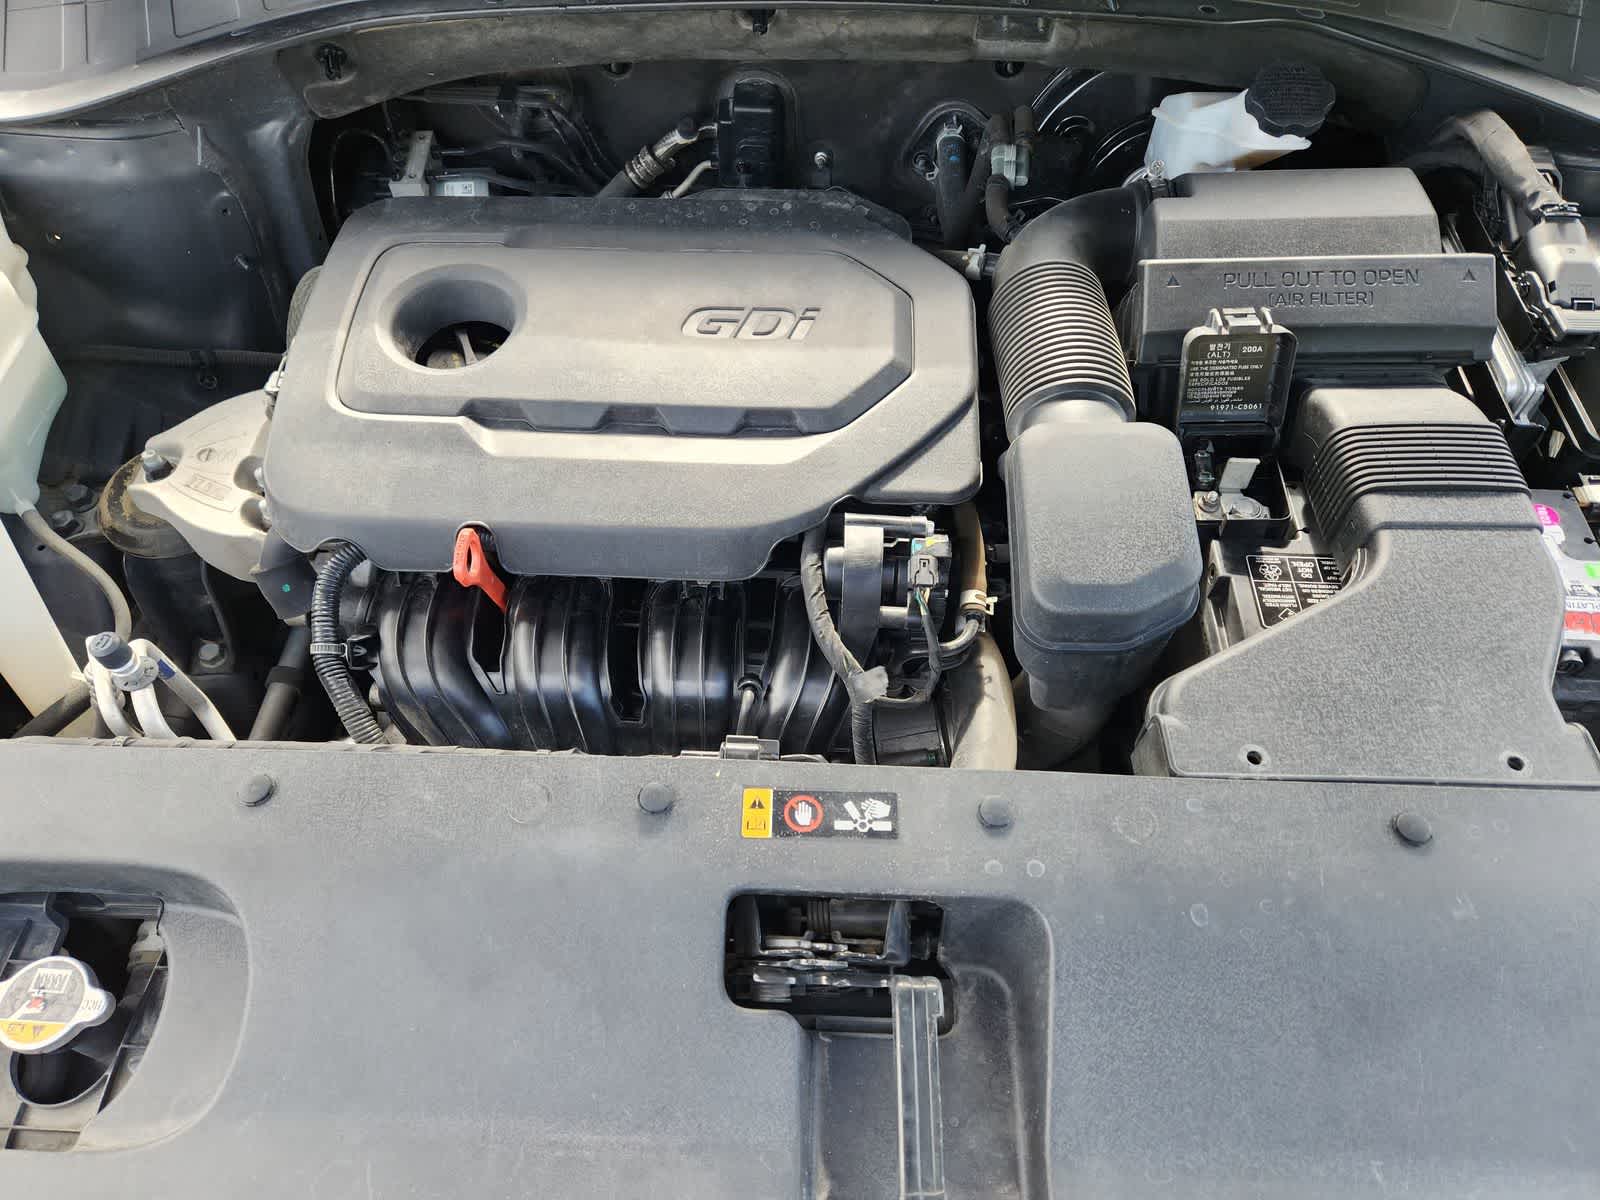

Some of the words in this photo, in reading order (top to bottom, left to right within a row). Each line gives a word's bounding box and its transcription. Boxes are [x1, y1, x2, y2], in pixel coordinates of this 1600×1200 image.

[1223, 272, 1276, 289] PULL
[1281, 271, 1325, 288] OUT
[1330, 270, 1357, 286] TO
[1363, 269, 1420, 286] OPEN
[681, 306, 821, 341] GDi
[1209, 343, 1231, 351] 발전기
[1207, 351, 1231, 359] (ALT)
